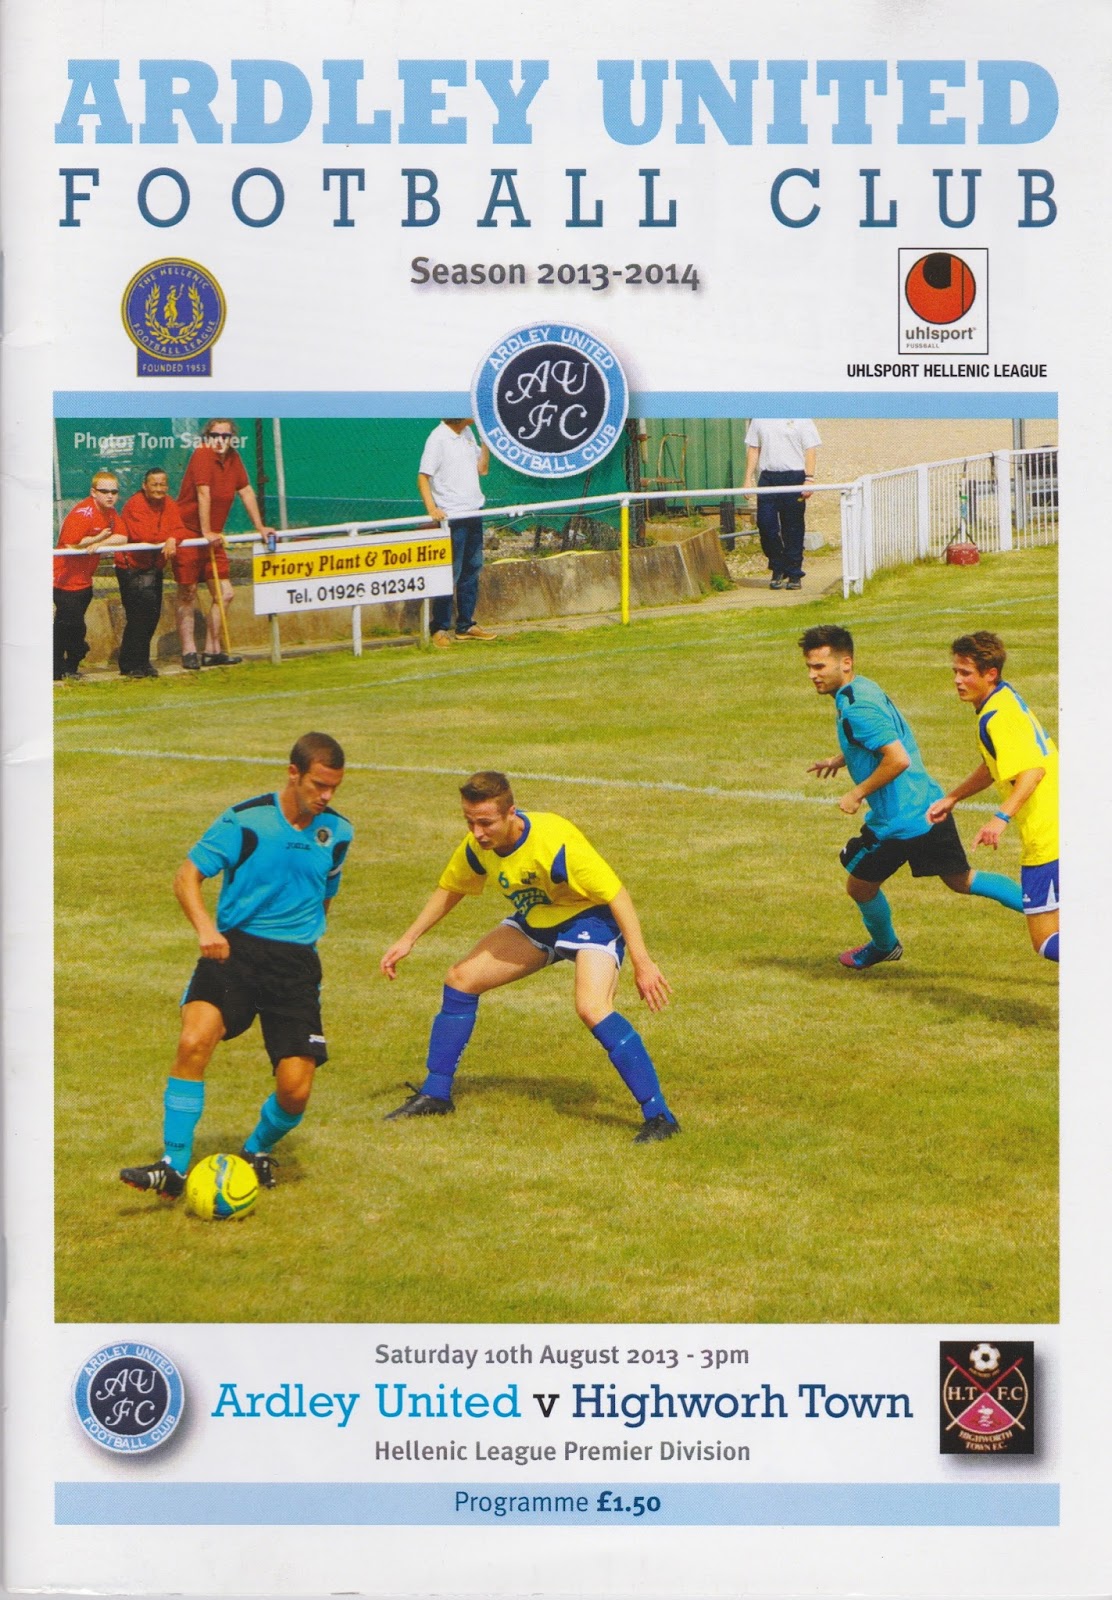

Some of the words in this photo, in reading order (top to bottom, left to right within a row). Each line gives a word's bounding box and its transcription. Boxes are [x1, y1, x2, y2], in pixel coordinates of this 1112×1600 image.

[55, 60, 549, 145] ARDLEY
[597, 60, 1059, 145] UNITED
[58, 168, 677, 229] FOOTBALL
[770, 168, 1058, 229] CLUB
[139, 273, 157, 289] THE
[160, 267, 209, 289] HELLENIC
[410, 256, 526, 285] Season
[537, 263, 701, 291] 2013-2014
[133, 322, 180, 354] FOOTBALL
[184, 320, 215, 352] LEAGUE
[488, 328, 550, 370] ARDLEY
[561, 329, 614, 369] UNITED
[905, 326, 974, 343] uhlsport
[142, 363, 183, 373] FOUNDED
[186, 363, 207, 373] 1953
[847, 363, 920, 378] UHLSPORT
[923, 363, 990, 378] HELLENIC
[993, 363, 1048, 378] LEAGUE
[488, 427, 577, 471] FOOTBALL
[581, 424, 617, 461] CLUB
[261, 559, 314, 577] Priory
[319, 553, 360, 571] Plant
[365, 551, 378, 567] &
[382, 546, 412, 566] Tool
[417, 544, 446, 562] Hire
[287, 588, 312, 605] Tel.
[317, 582, 366, 601] 01926
[371, 576, 426, 596] 812343
[498, 871, 509, 889] 6
[84, 1345, 128, 1376] ARDLEY
[135, 1346, 174, 1376] UNITED
[375, 1344, 478, 1369] Saturday
[485, 1344, 533, 1364] 10th
[540, 1344, 620, 1369] August
[627, 1349, 679, 1369] 2013
[700, 1349, 749, 1369] 3pm
[211, 1383, 361, 1428] Ardley
[375, 1383, 522, 1418] United
[533, 1394, 561, 1418] v
[572, 1384, 788, 1428] Highworh
[798, 1384, 914, 1418] Town
[83, 1417, 147, 1449] FOOTBALL
[151, 1414, 176, 1440] CLUB
[958, 1430, 1014, 1443] HIGHWORTH
[375, 1440, 468, 1461] Hellenic
[476, 1441, 557, 1465] League
[564, 1440, 653, 1461] Premier
[660, 1440, 750, 1461] Division
[965, 1442, 991, 1451] TOWN
[455, 1491, 589, 1516] Programme
[596, 1490, 662, 1517] £1.50
